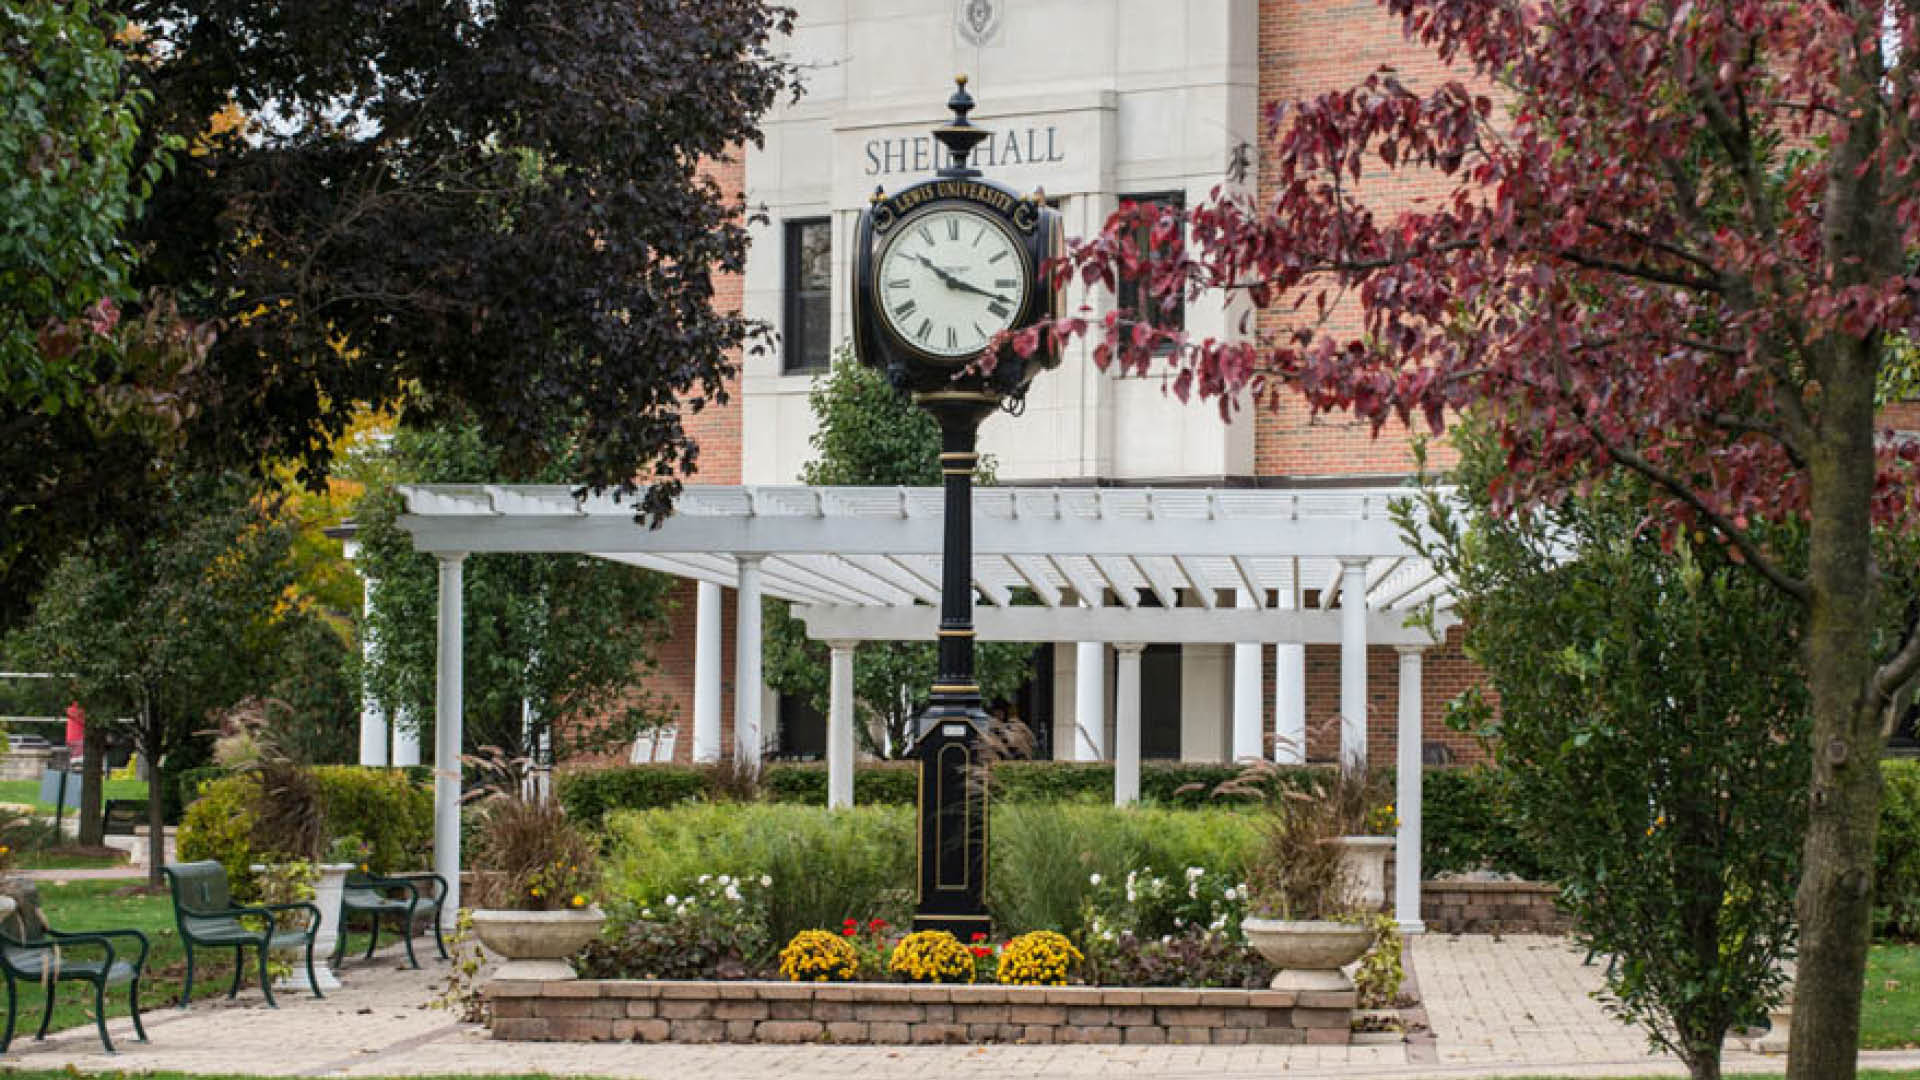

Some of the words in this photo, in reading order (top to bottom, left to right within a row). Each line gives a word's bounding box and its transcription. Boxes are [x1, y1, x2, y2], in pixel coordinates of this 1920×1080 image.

[971, 126, 1065, 167] HALL
[896, 184, 934, 212] LEWIS
[938, 182, 1014, 213] UNIVERSITY
